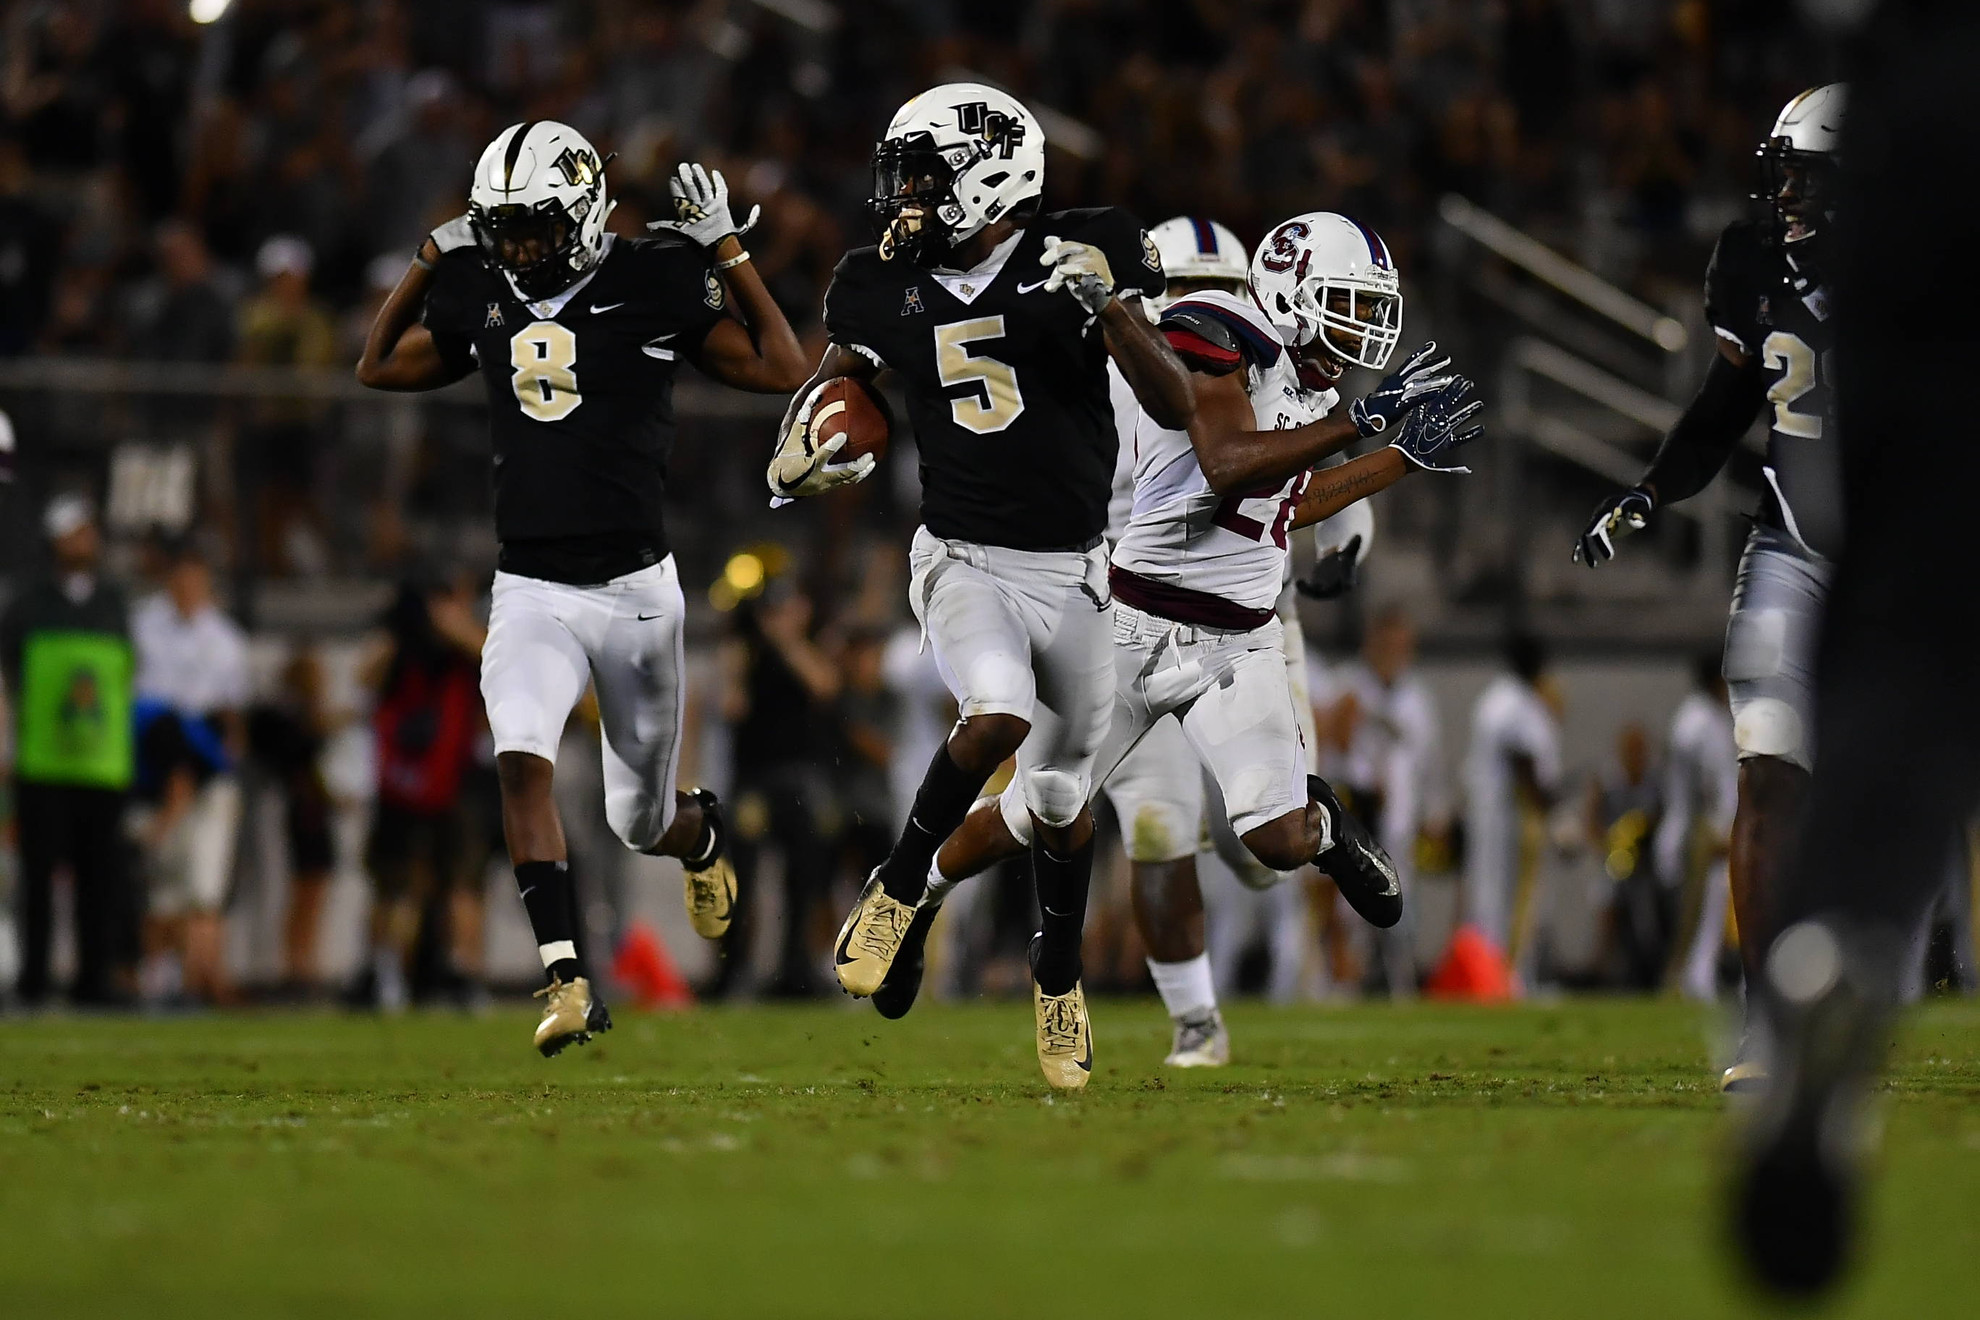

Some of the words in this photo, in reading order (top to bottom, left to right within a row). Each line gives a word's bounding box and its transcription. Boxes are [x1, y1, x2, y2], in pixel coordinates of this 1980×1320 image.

[947, 101, 1026, 160] UCF
[511, 321, 583, 422] 8
[933, 314, 1026, 435] 5
